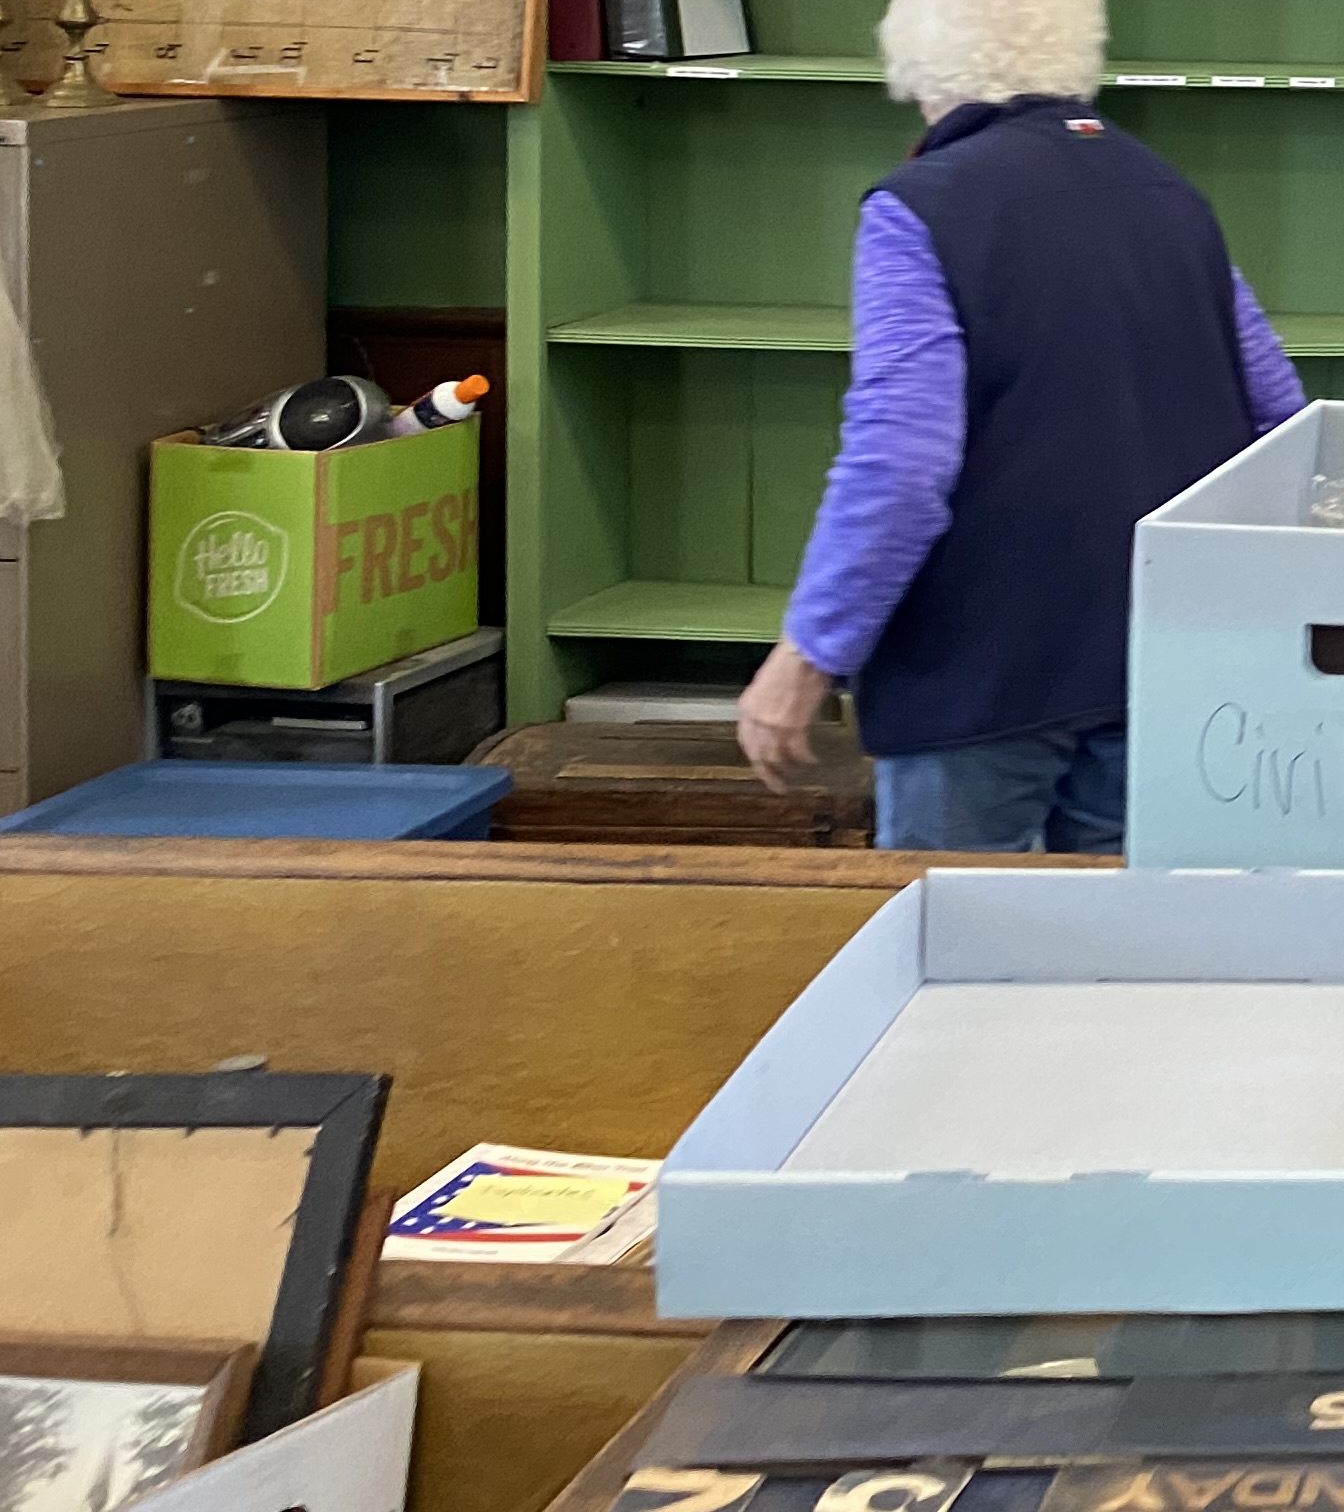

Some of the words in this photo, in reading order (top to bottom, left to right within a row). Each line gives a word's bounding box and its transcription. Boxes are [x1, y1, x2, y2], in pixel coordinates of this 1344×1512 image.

[194, 530, 270, 570] Hello
[320, 487, 479, 614] FRESH
[205, 567, 269, 601] FRESH
